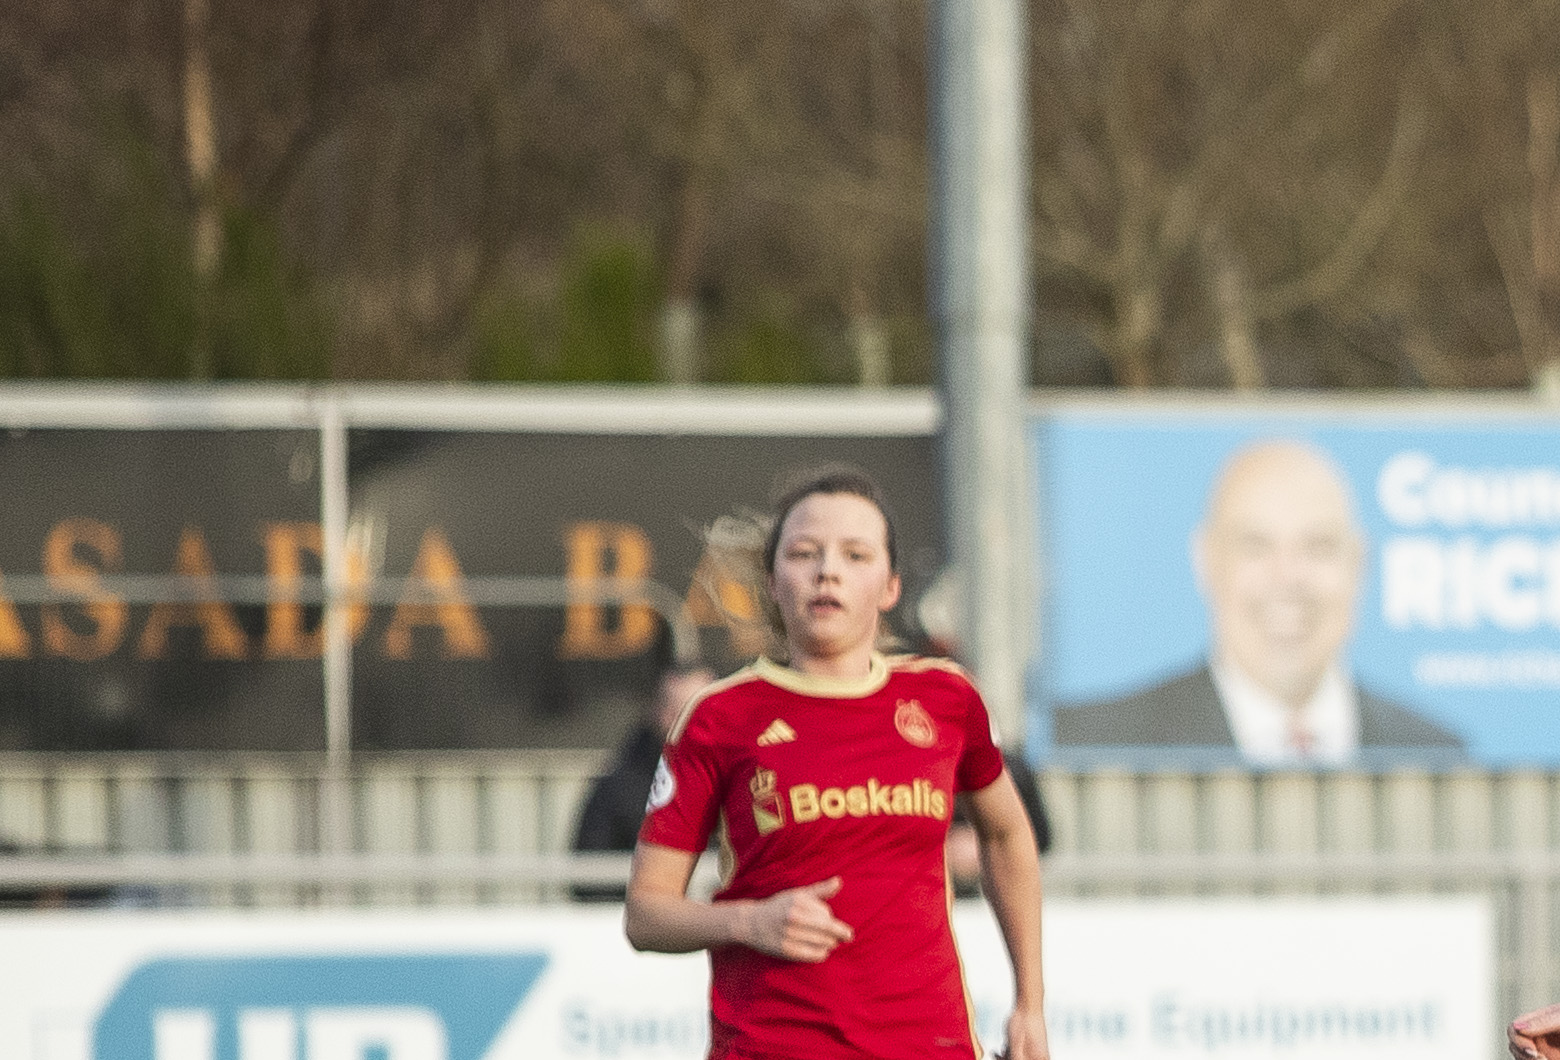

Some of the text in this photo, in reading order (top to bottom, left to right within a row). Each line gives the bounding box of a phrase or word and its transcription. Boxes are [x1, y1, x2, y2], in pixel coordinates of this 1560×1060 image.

[0, 515, 491, 660] SADA
[788, 777, 949, 825] Boskalis
[1150, 994, 1444, 1050] Equipment
